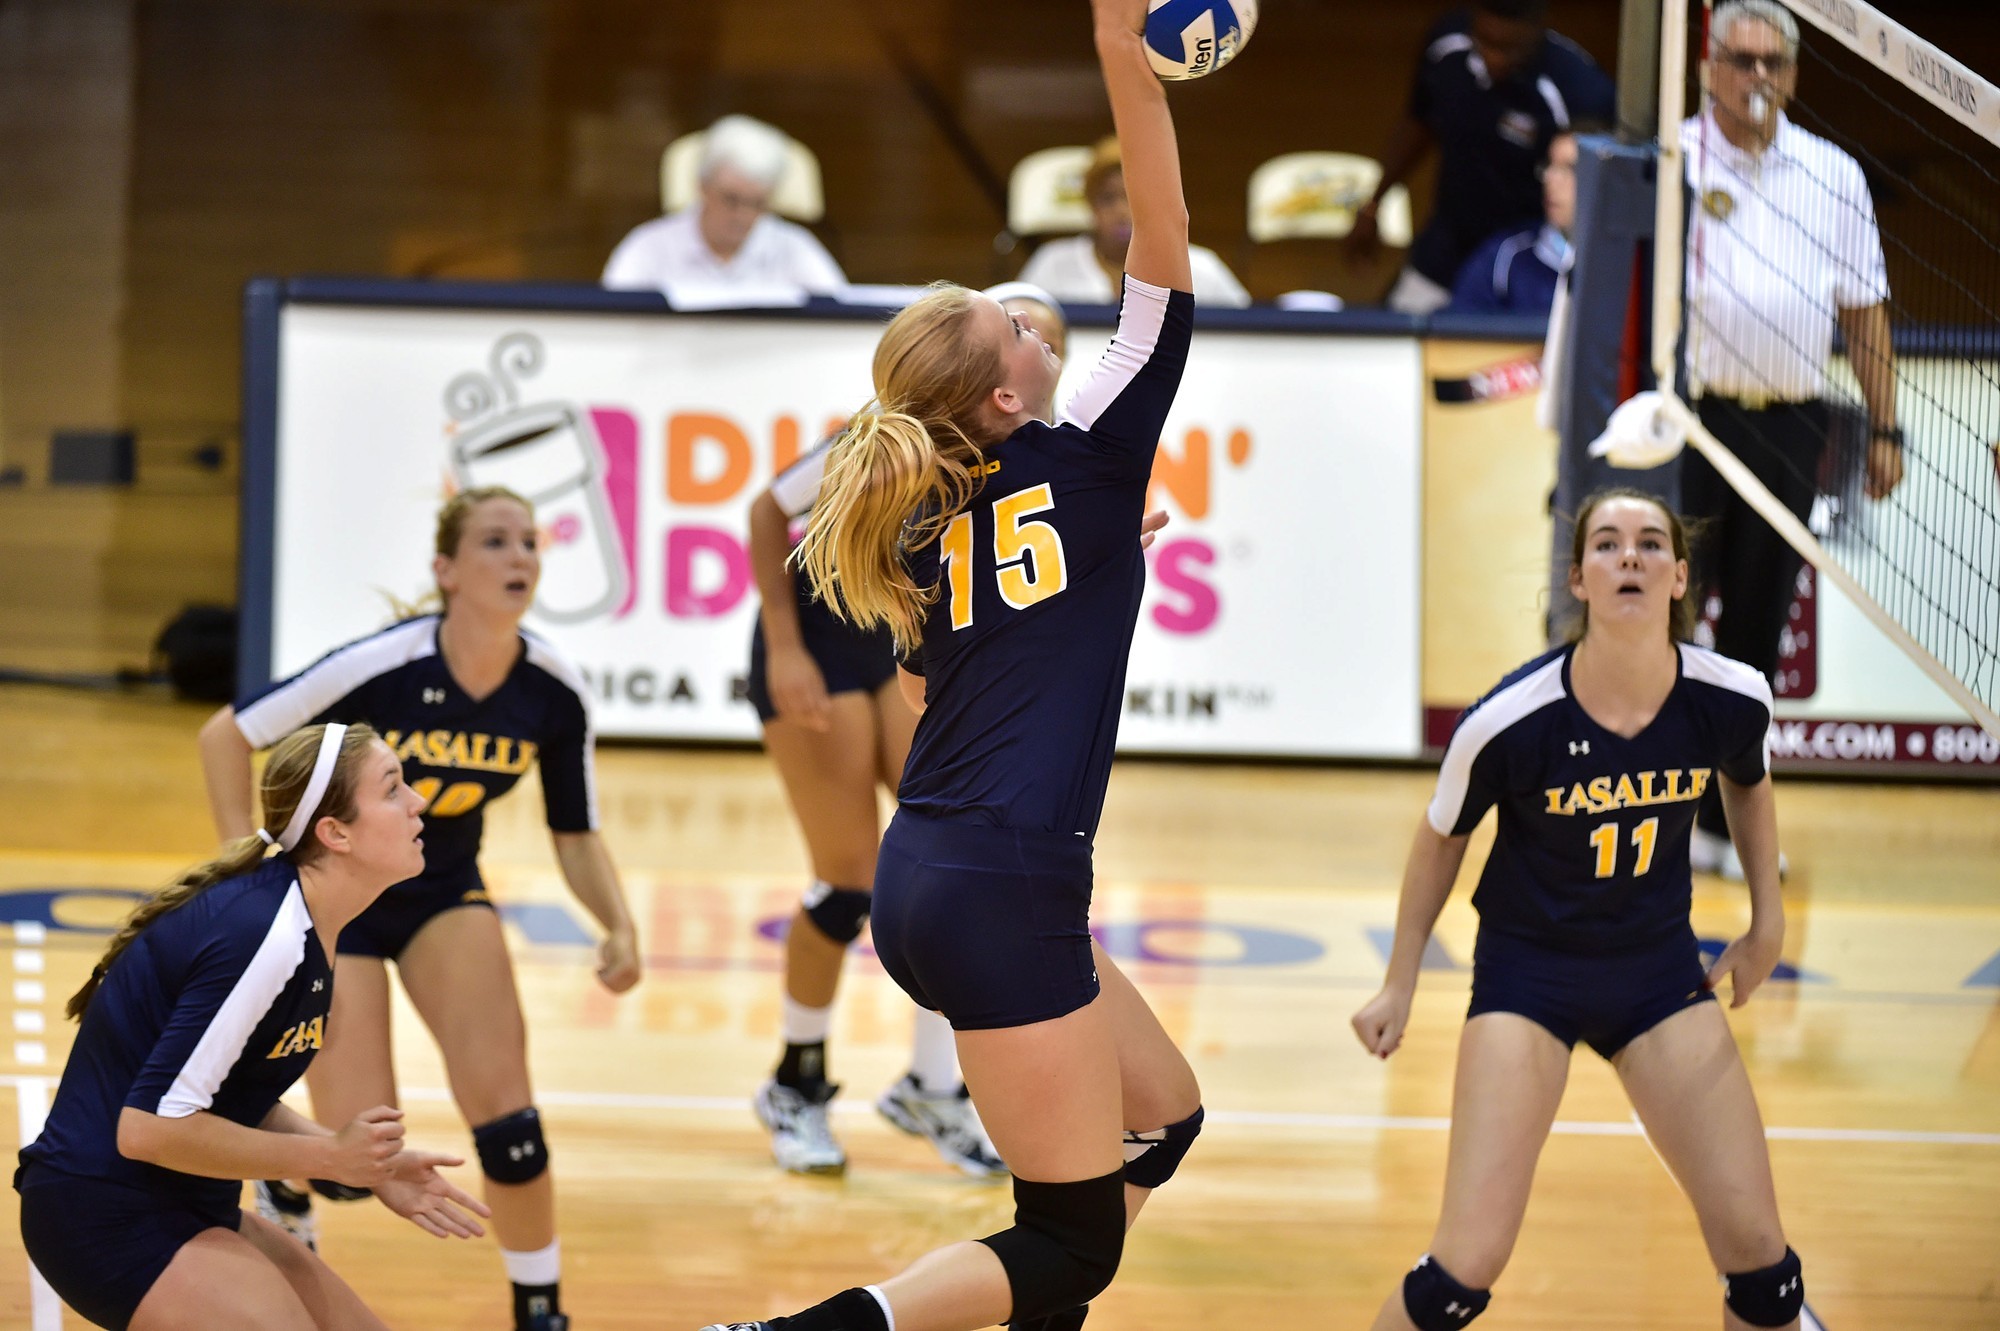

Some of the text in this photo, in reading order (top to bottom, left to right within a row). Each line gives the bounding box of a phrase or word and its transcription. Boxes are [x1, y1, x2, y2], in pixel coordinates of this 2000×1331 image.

[1187, 38, 1212, 76] lten
[940, 482, 1068, 631] 15
[577, 667, 697, 704] ICA
[1589, 816, 1659, 879] 11
